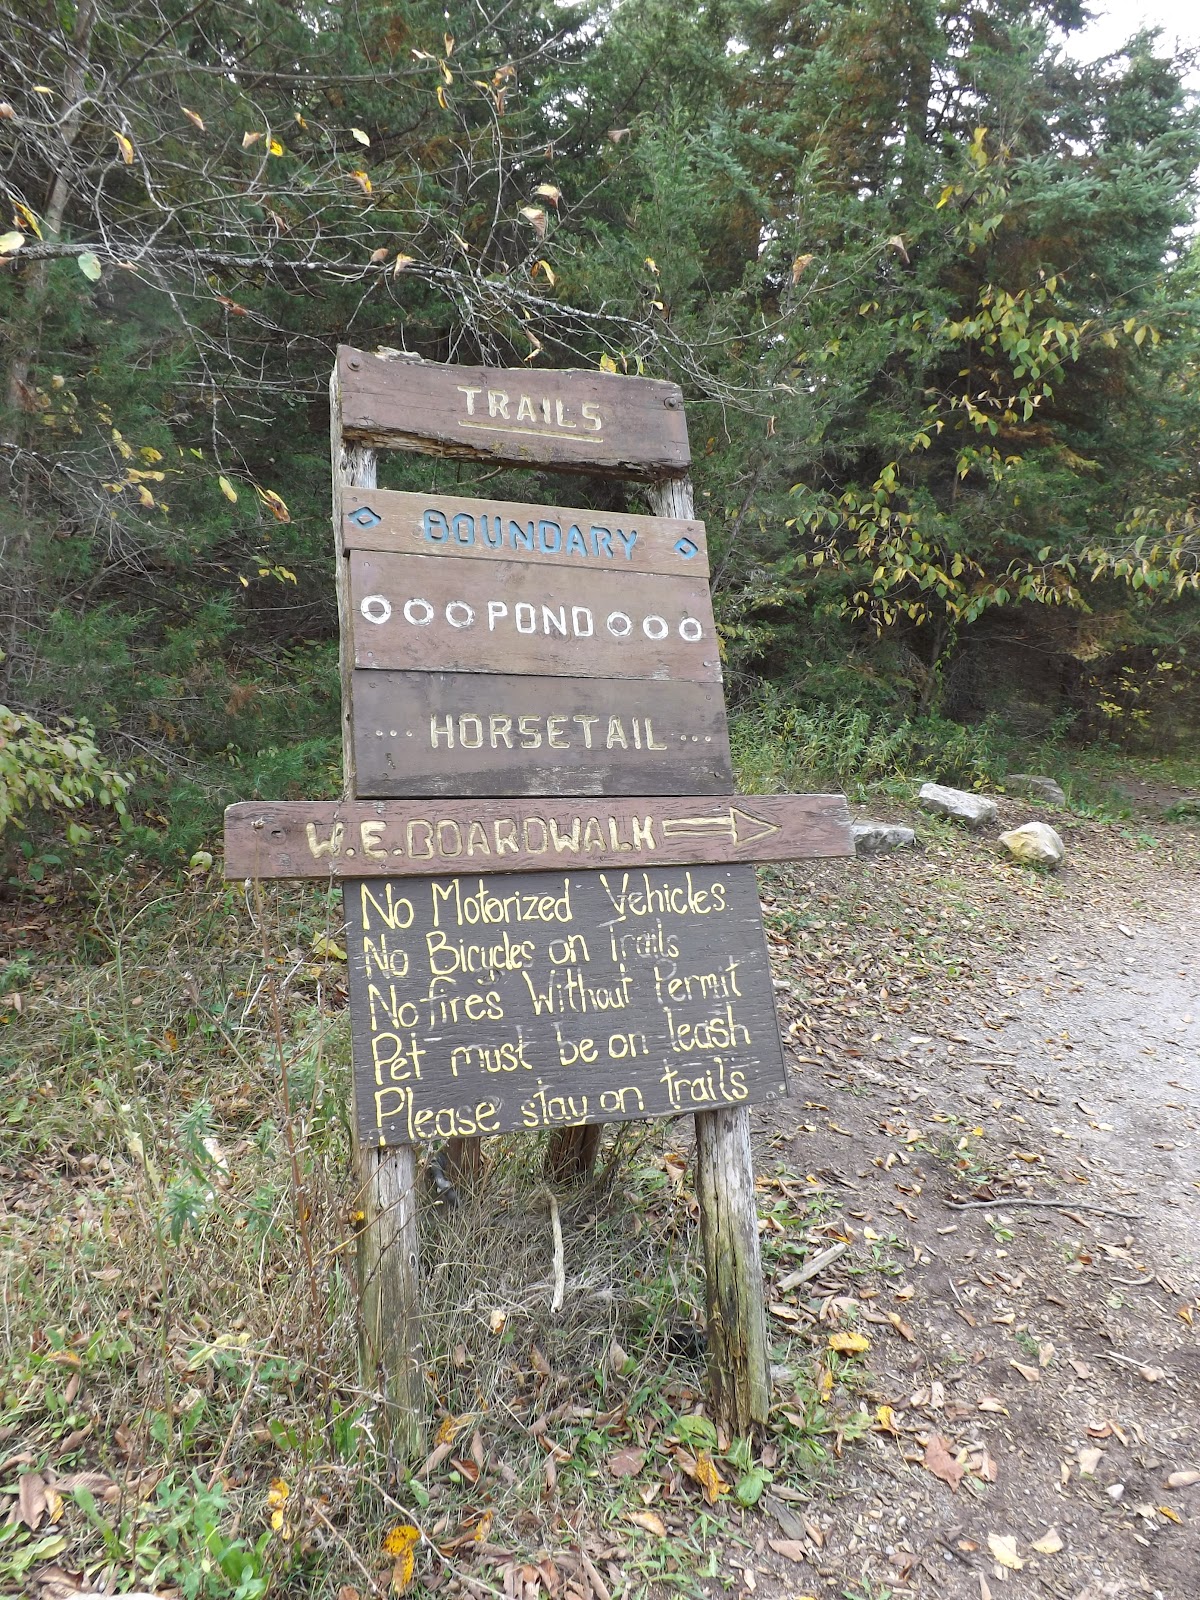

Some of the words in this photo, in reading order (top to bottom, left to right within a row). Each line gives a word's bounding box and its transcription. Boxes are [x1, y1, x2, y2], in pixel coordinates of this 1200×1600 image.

[457, 385, 603, 431] TRAILS
[423, 508, 638, 560] BOUNDARY
[487, 600, 594, 638] POND
[430, 713, 667, 751] HORSETAIL
[360, 883, 415, 931] No
[431, 878, 573, 928] Motorized
[361, 933, 409, 980] No
[425, 929, 536, 985] Bicycles
[548, 934, 590, 966] on
[597, 915, 680, 962] Trails
[367, 984, 419, 1031] No
[420, 976, 505, 1032] fires
[521, 963, 634, 1016] Without
[654, 955, 742, 1004] Permit
[371, 1032, 427, 1086] Pet
[451, 1025, 534, 1077] must
[554, 1022, 598, 1067] be
[609, 1033, 649, 1059] on
[662, 1003, 752, 1053] leash
[374, 1086, 502, 1147] Please
[519, 1078, 590, 1128] stay
[600, 1087, 646, 1114] on
[659, 1057, 751, 1111] trails
